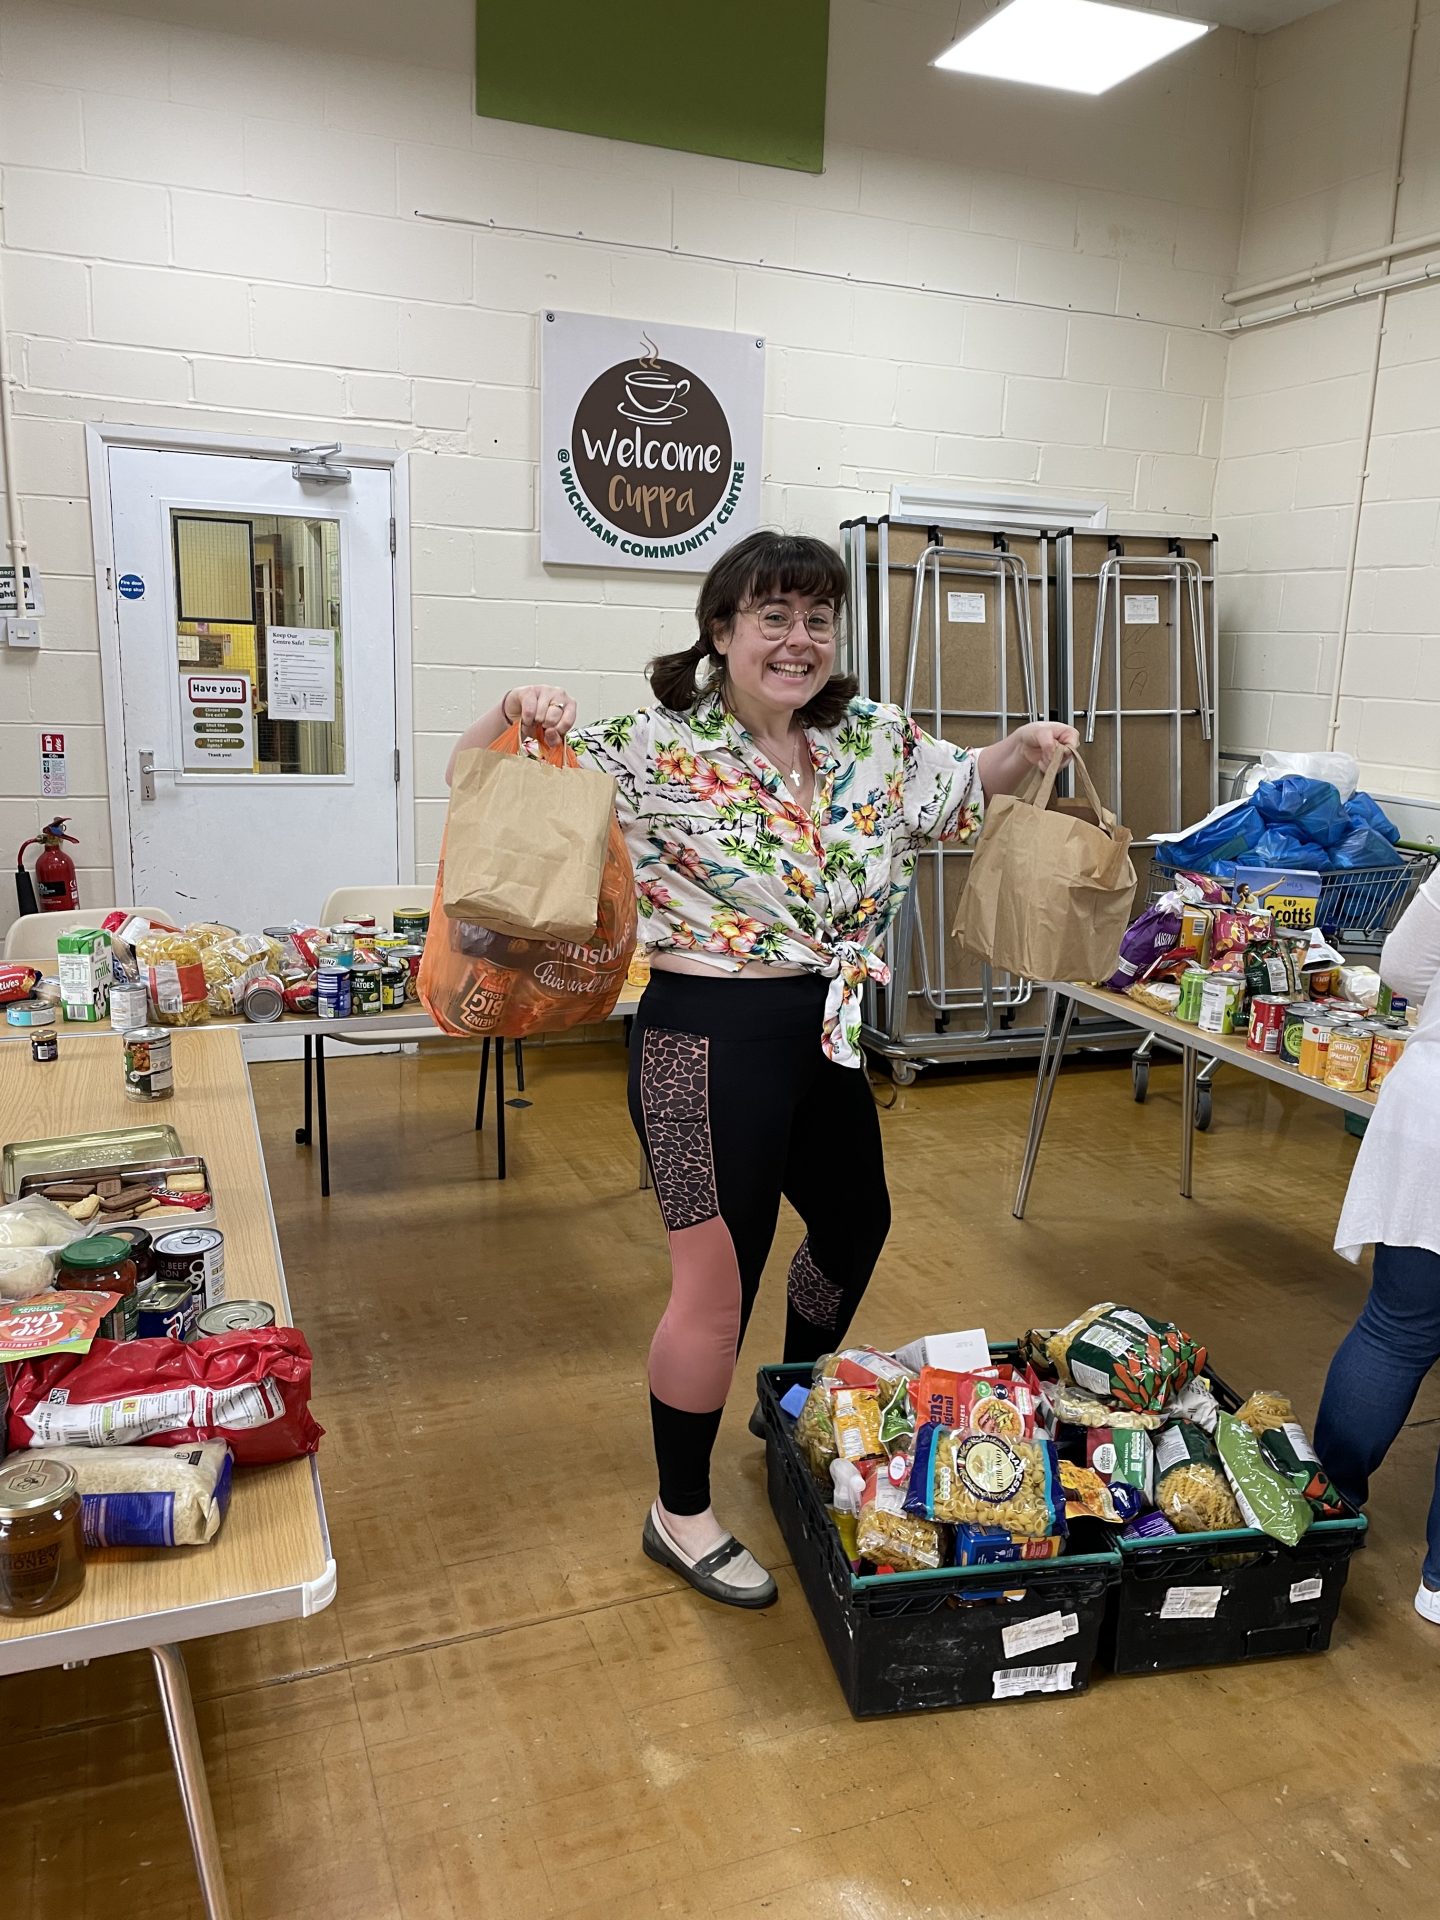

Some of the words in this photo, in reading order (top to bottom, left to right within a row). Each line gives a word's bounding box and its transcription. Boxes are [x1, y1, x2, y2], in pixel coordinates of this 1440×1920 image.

[558, 449, 570, 463] @
[582, 426, 721, 473] Welcome
[608, 475, 695, 528] Cuppa
[716, 461, 745, 525] CENTRE
[560, 466, 619, 547] WICKHAM
[620, 522, 718, 558] COMMUNITY
[193, 684, 217, 693] Have
[220, 686, 241, 695] you:
[94, 960, 111, 980] milk
[534, 961, 565, 990] live
[470, 994, 505, 1016] BIG
[481, 990, 505, 1000] SOUP
[466, 1013, 494, 1027] HEINZ
[1334, 1043, 1357, 1052] HEINZ
[167, 1262, 188, 1270] BEEF
[11, 1321, 64, 1338] Cup
